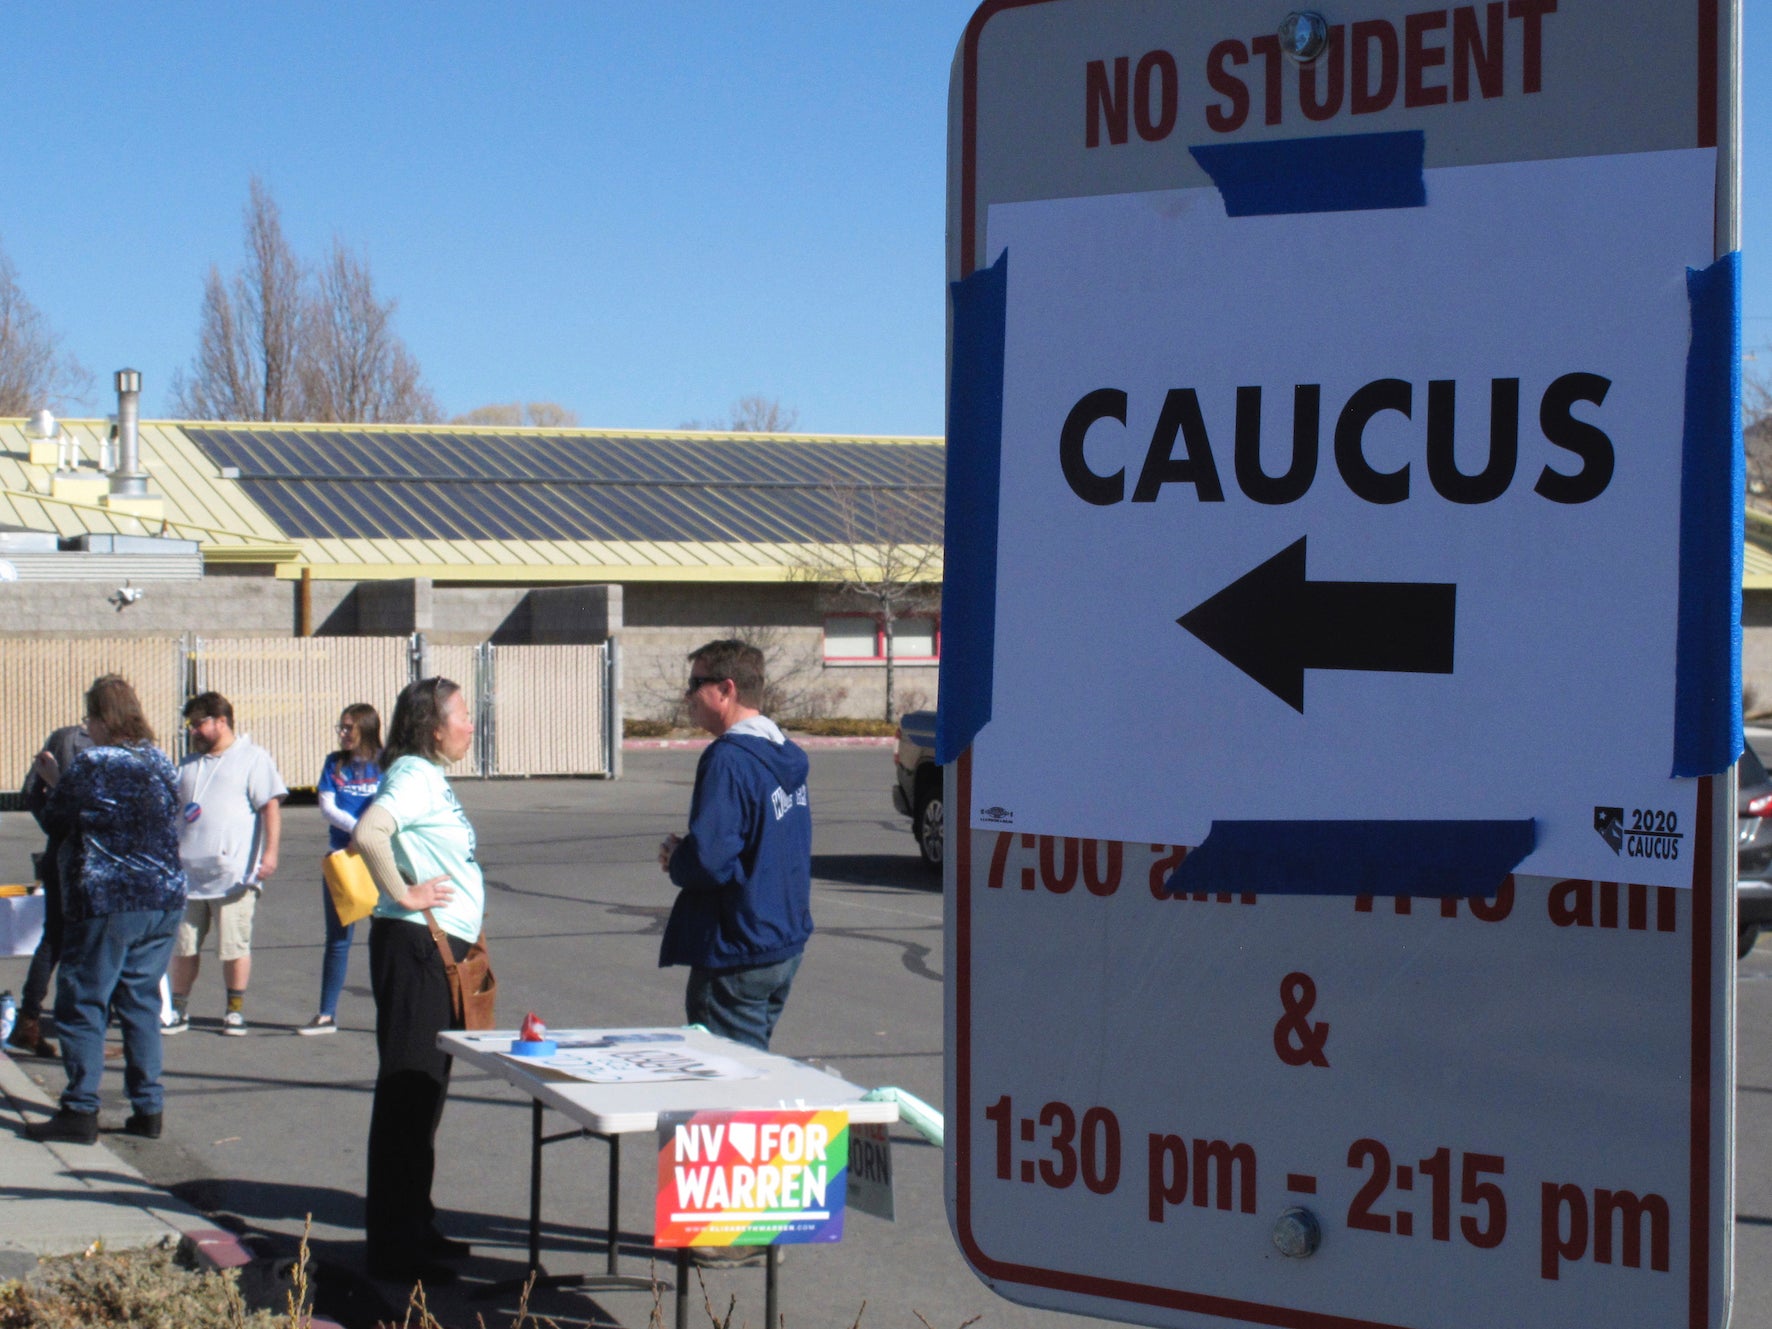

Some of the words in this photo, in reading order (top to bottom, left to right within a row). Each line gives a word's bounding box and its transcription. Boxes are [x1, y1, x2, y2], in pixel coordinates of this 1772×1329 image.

[1086, 50, 1177, 148] NO
[1206, 0, 1558, 133] STUDENT
[1059, 371, 1616, 506] CAUCUS
[1632, 808, 1677, 832] 2020
[1627, 835, 1679, 861] CAUCUS
[1273, 971, 1331, 1068] &
[674, 1124, 725, 1162] NV
[760, 1123, 828, 1162] FOR
[848, 1136, 889, 1187] ORN
[674, 1165, 827, 1209] WARREN
[985, 1095, 1121, 1195] 1:30
[1147, 1133, 1258, 1223] pm
[1286, 1173, 1317, 1194] -
[1346, 1138, 1508, 1249] 2:15
[1541, 1180, 1670, 1281] pm
